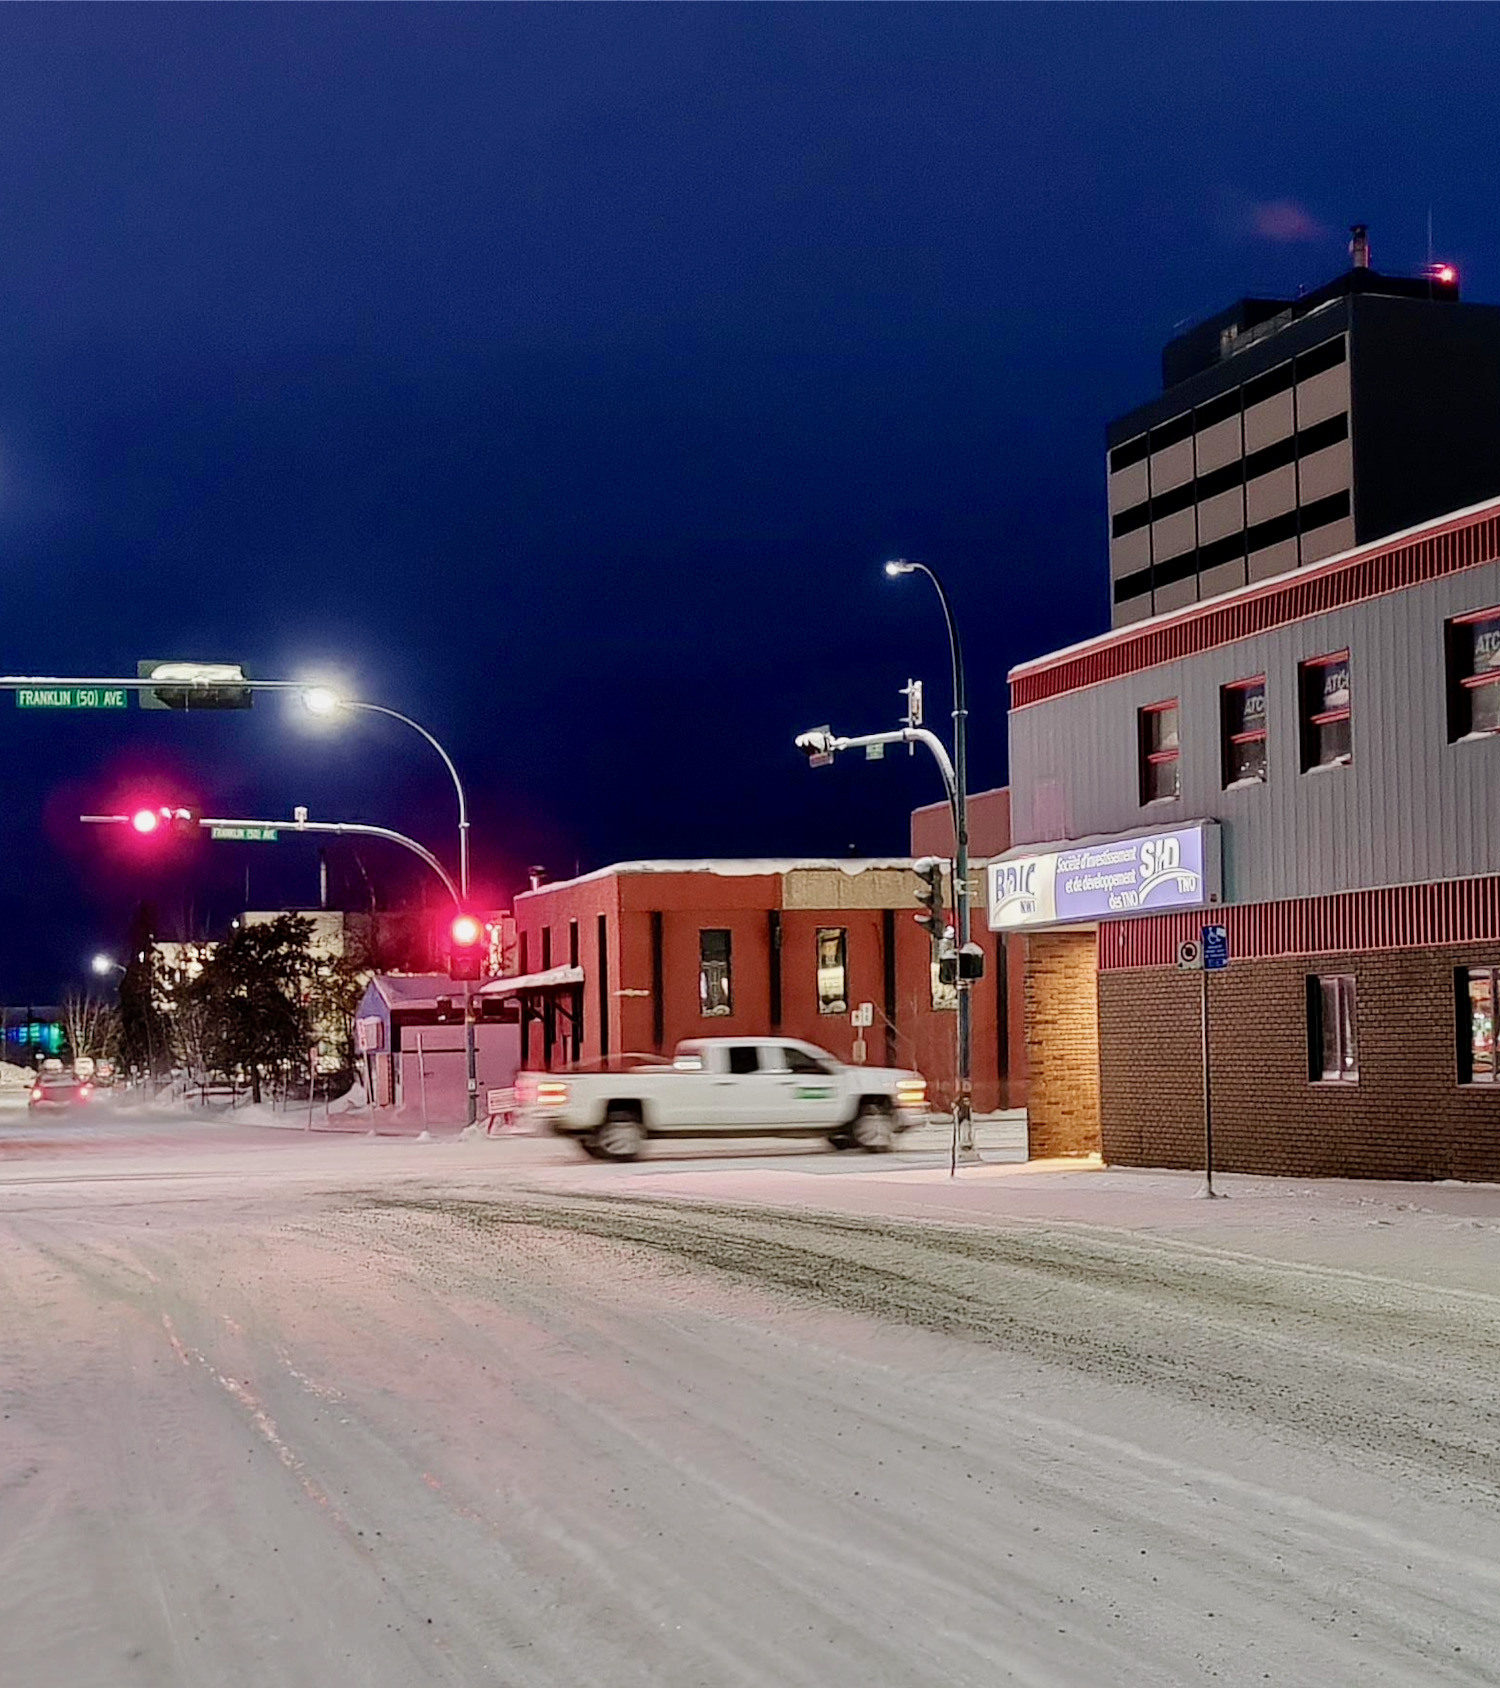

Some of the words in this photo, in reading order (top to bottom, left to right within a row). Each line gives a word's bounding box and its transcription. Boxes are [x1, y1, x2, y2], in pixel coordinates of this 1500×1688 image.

[20, 690, 71, 706] FRANKLIN
[76, 689, 98, 706] (50)
[103, 691, 123, 706] AVE
[1057, 854, 1080, 873] Société
[1065, 880, 1073, 893] et
[1073, 876, 1083, 892] de
[1083, 869, 1137, 893] développement
[1176, 876, 1197, 893] TNO
[1019, 900, 1036, 914] NWT
[1108, 893, 1123, 909] des
[1122, 890, 1138, 906] TNO
